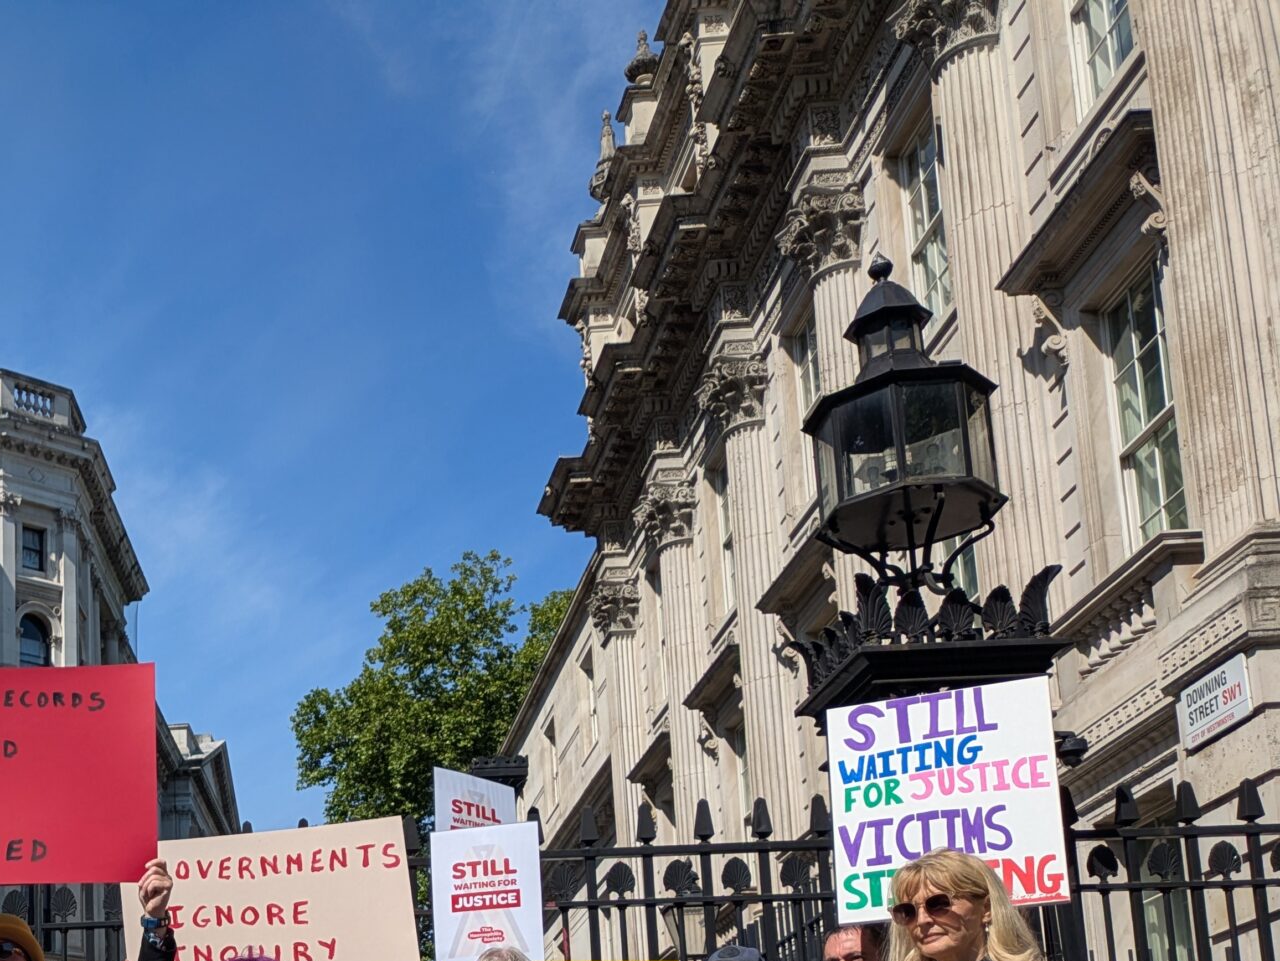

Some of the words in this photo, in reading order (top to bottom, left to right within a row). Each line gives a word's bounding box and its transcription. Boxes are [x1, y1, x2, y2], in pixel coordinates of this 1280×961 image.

[1186, 670, 1227, 709] DOWNING
[1188, 695, 1220, 726] STREET
[1222, 681, 1242, 706] SW1
[843, 686, 999, 751] STILL
[838, 734, 984, 785] WAITING
[844, 778, 904, 813] FOR
[909, 754, 1051, 800] JUSTICE
[451, 798, 501, 825] STILL
[838, 804, 1014, 867] VICTIMS
[175, 843, 401, 881] OVERNMENTS
[452, 857, 518, 880] STILL
[453, 880, 496, 891] WAITING
[497, 878, 517, 888] FOR
[454, 892, 518, 909] JUSTICE
[168, 900, 309, 930] IGNORE
